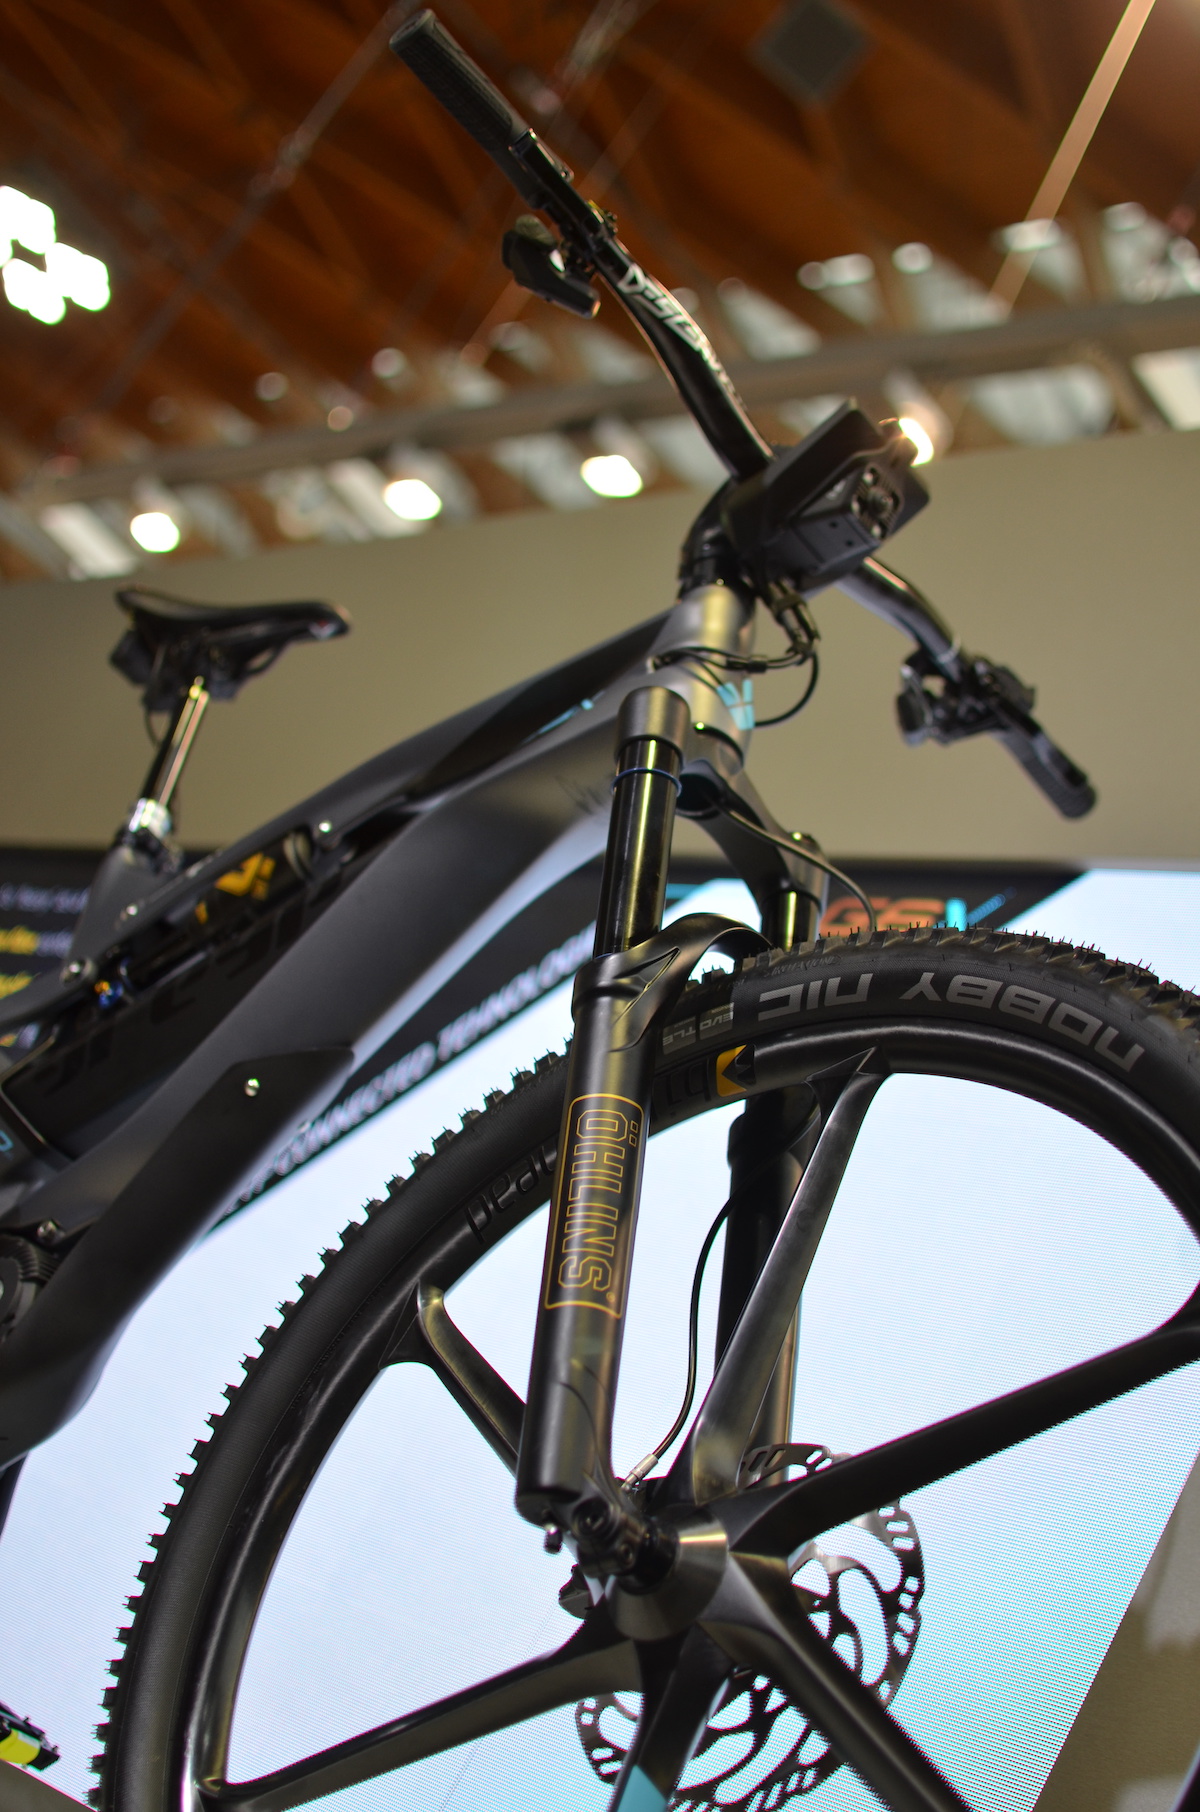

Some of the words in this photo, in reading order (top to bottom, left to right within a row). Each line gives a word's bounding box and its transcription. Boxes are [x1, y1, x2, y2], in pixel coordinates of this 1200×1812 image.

[758, 972, 874, 1022] NIC
[662, 1028, 697, 1046] TLE
[700, 1008, 734, 1031] EVO
[900, 972, 1145, 1073] NOBBY
